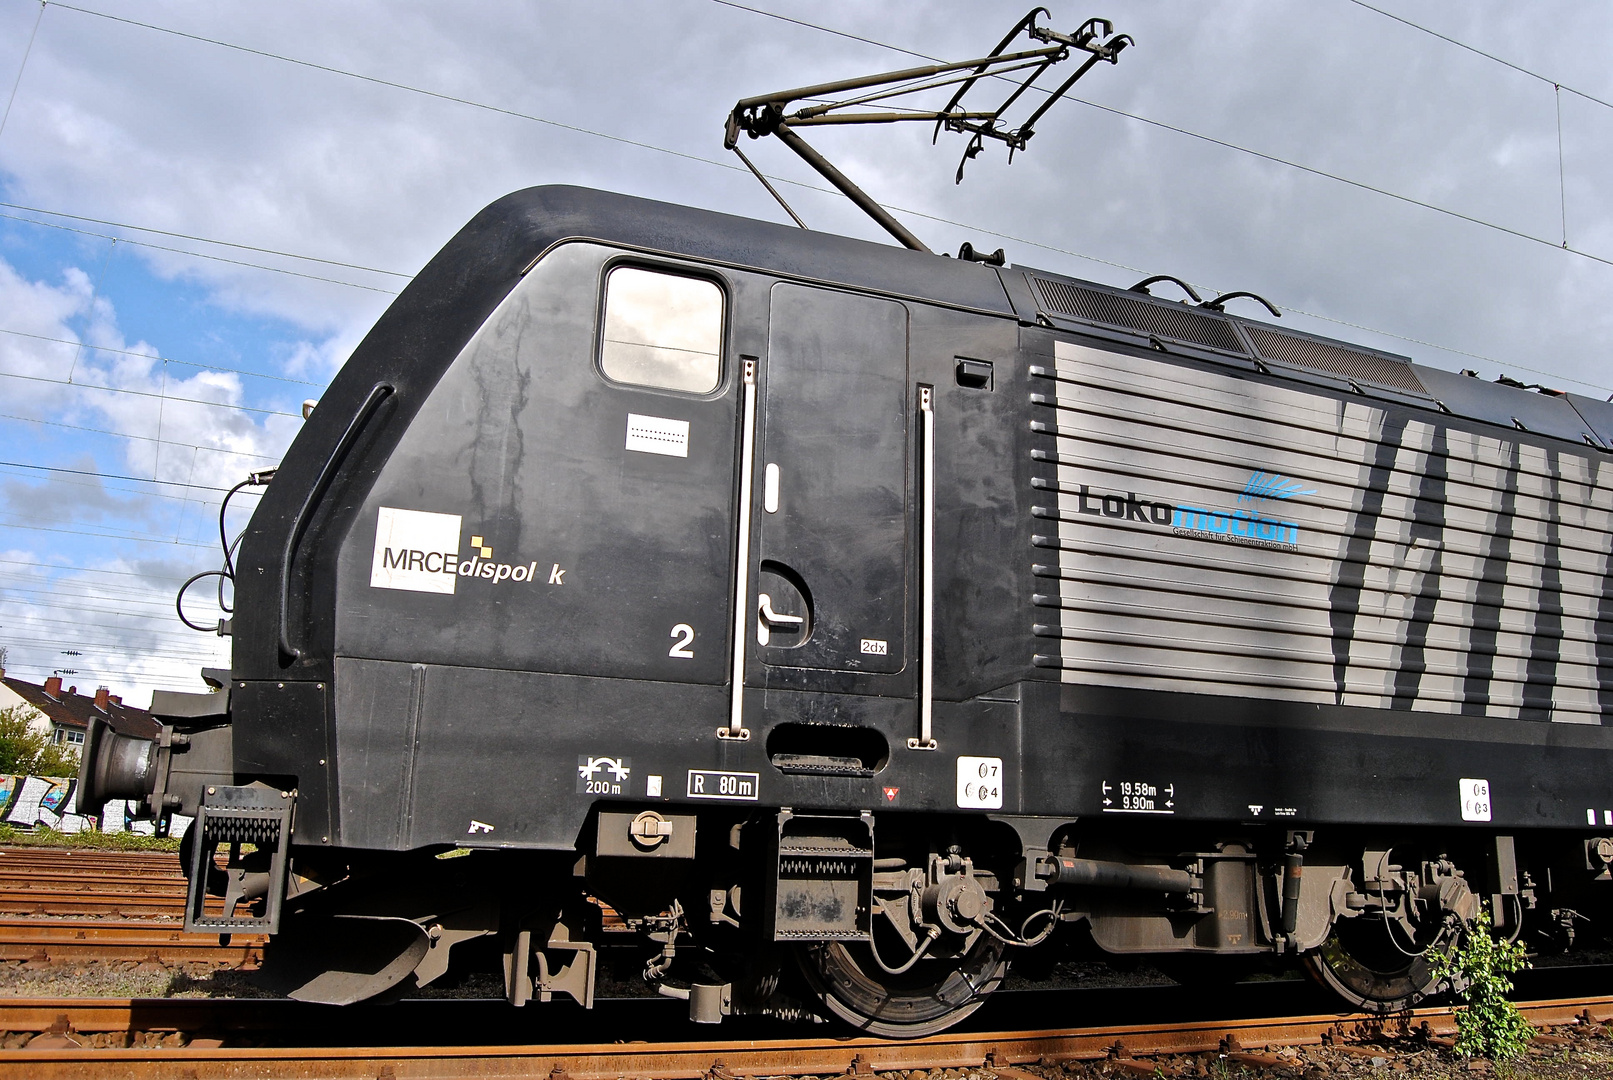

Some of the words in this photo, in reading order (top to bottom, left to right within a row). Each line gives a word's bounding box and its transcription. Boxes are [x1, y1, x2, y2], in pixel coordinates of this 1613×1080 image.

[382, 547, 459, 575] MRCE
[668, 623, 695, 659] 2
[862, 641, 885, 654] 2dx
[694, 774, 705, 793] R
[1120, 782, 1157, 797] 19.58m
[1122, 796, 1155, 810] 9.90m
